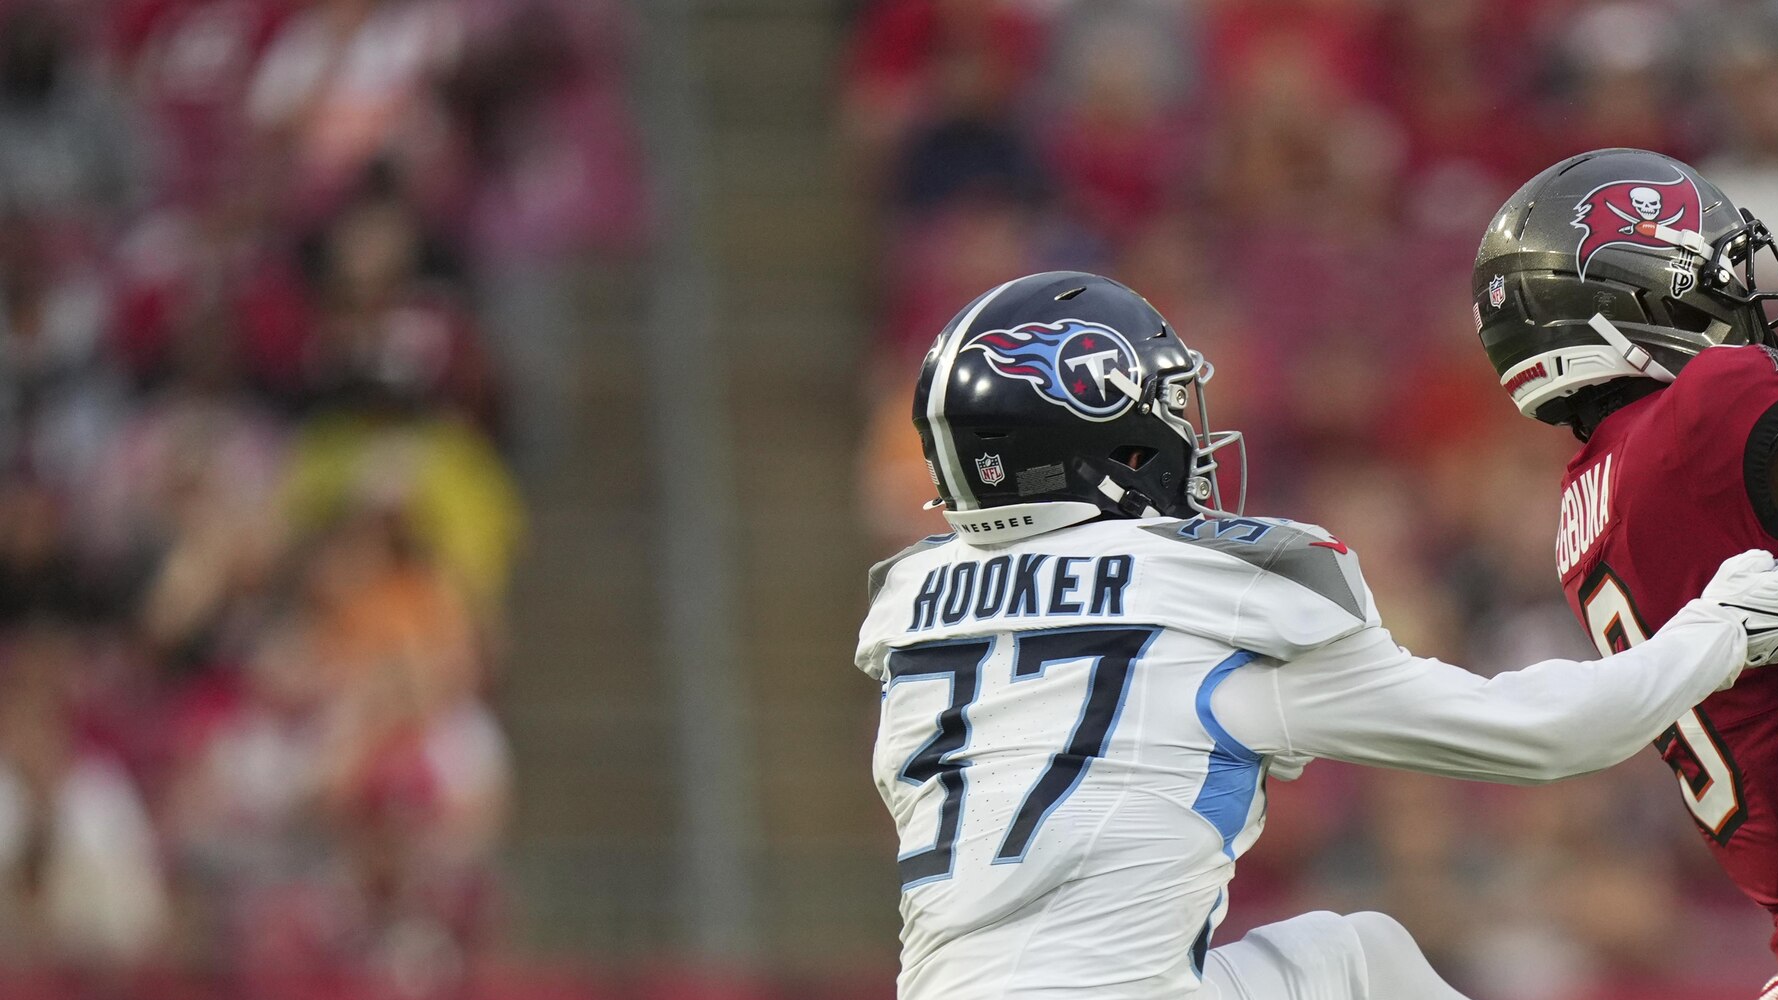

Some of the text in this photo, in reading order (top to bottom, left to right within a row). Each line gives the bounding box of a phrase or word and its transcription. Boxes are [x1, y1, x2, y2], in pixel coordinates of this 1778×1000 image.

[981, 466, 1002, 481] NFL
[906, 553, 1135, 632] HOOKER
[889, 623, 1165, 893] 37
